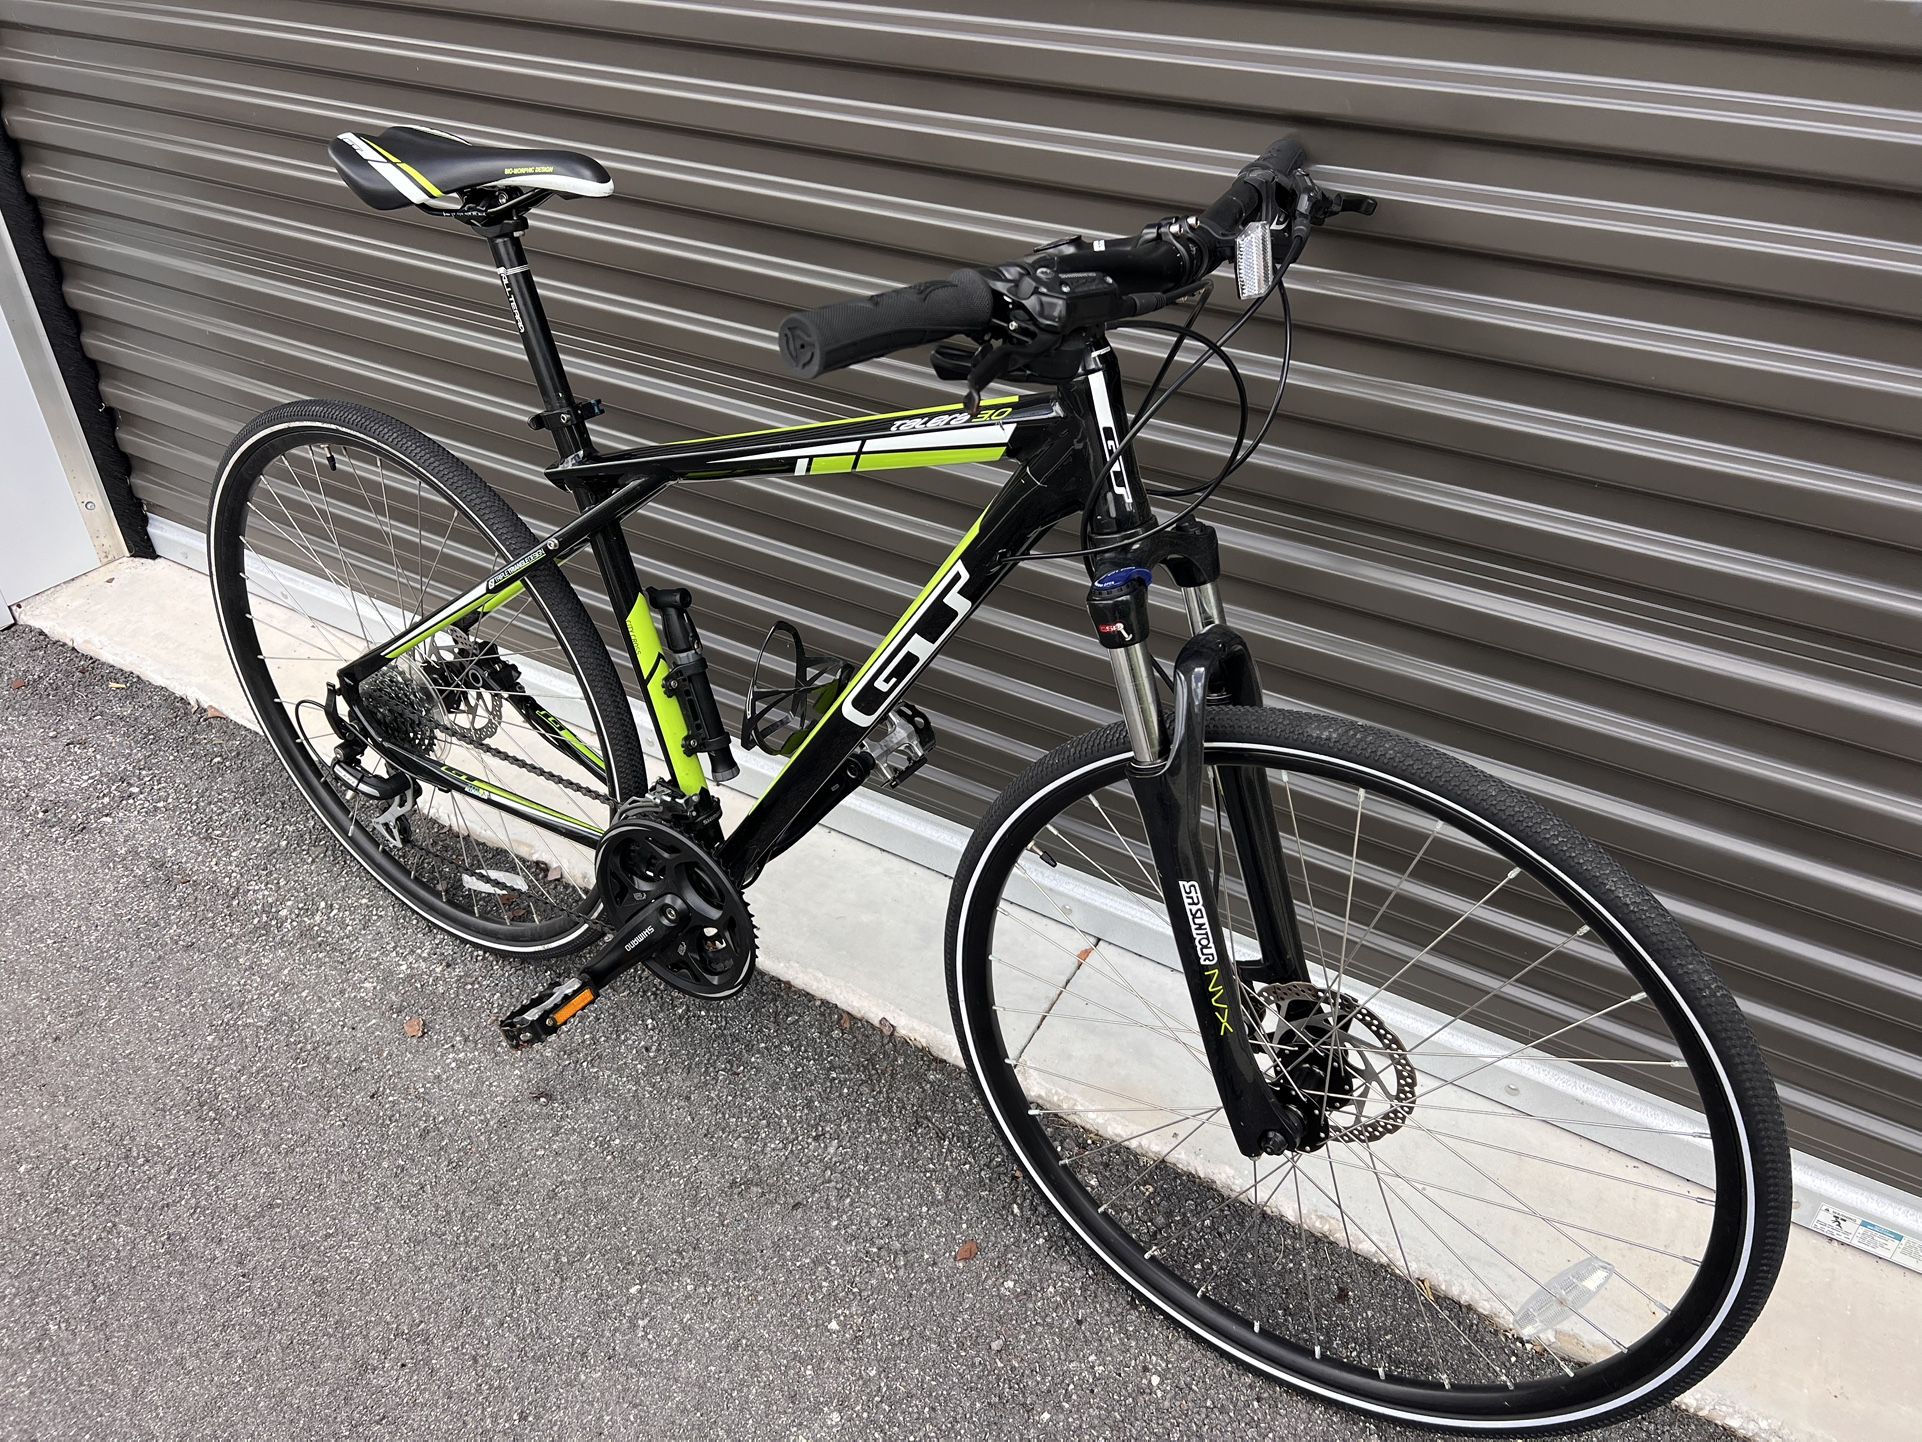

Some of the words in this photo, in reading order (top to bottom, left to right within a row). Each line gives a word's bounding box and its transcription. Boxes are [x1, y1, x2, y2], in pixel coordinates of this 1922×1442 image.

[971, 407, 1013, 422] 3.0
[630, 634, 642, 656] CROSS
[842, 558, 972, 728] GT
[1179, 880, 1201, 907] SR
[624, 925, 655, 952] SHIMANO
[1187, 906, 1218, 965] SUNTOUR
[1204, 968, 1234, 1036] NVX
